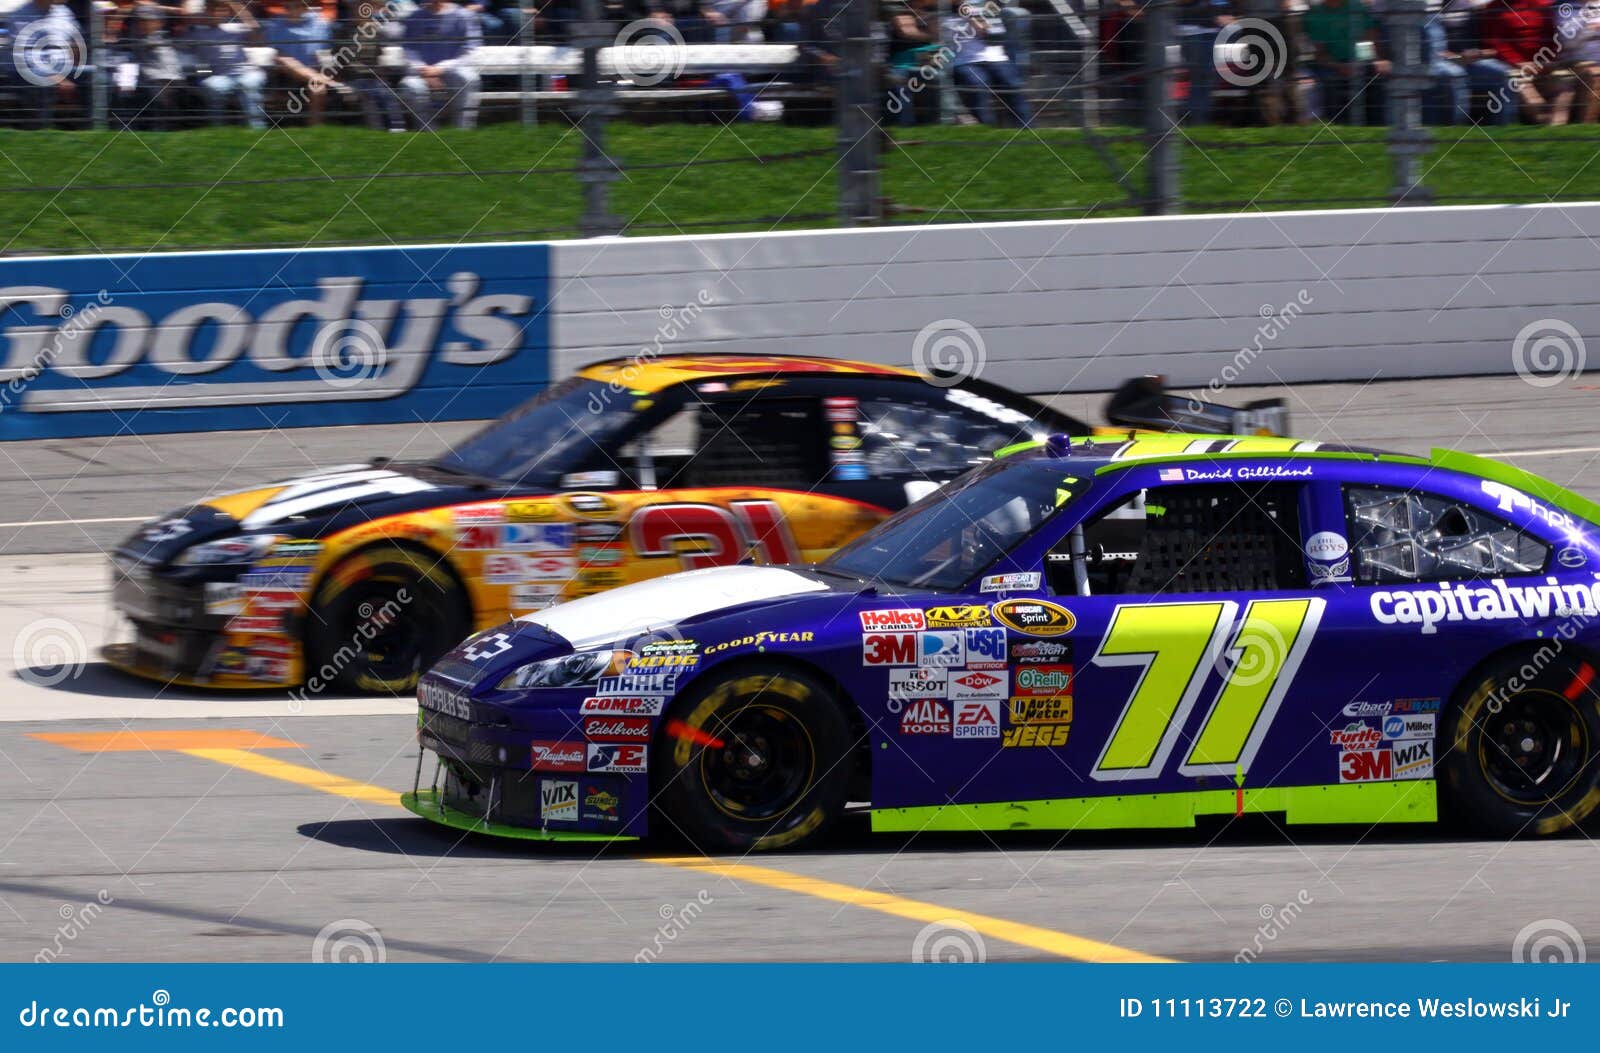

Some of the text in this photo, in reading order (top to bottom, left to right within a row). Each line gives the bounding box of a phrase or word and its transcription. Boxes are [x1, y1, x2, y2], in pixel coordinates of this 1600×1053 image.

[1186, 466, 1313, 480] David Gilliland
[1015, 605, 1042, 613] NASCAR
[861, 611, 924, 629] Holley
[1021, 613, 1049, 624] Sprint
[703, 631, 814, 655] GOODYEAR
[864, 635, 916, 664] 3M
[966, 629, 1005, 661] USG
[626, 654, 699, 668] MOOG
[598, 674, 675, 692] MAHLE
[890, 680, 947, 692] TISSOT
[1018, 669, 1071, 690] O'Reilly
[1089, 597, 1328, 782] 71
[585, 698, 643, 711] COMP
[902, 700, 950, 723] MAC
[956, 703, 997, 725] EA
[585, 720, 649, 737] Edelbrock
[903, 724, 950, 734] TOOLS
[955, 725, 998, 736] SPORTS
[1405, 721, 1433, 732] Miller
[1002, 725, 1071, 748] JEGS
[1330, 728, 1383, 745] Turtle
[1343, 742, 1377, 751] WAX
[1394, 741, 1431, 767] WIX
[1341, 751, 1392, 781] 3M
[542, 783, 576, 807] WIX
